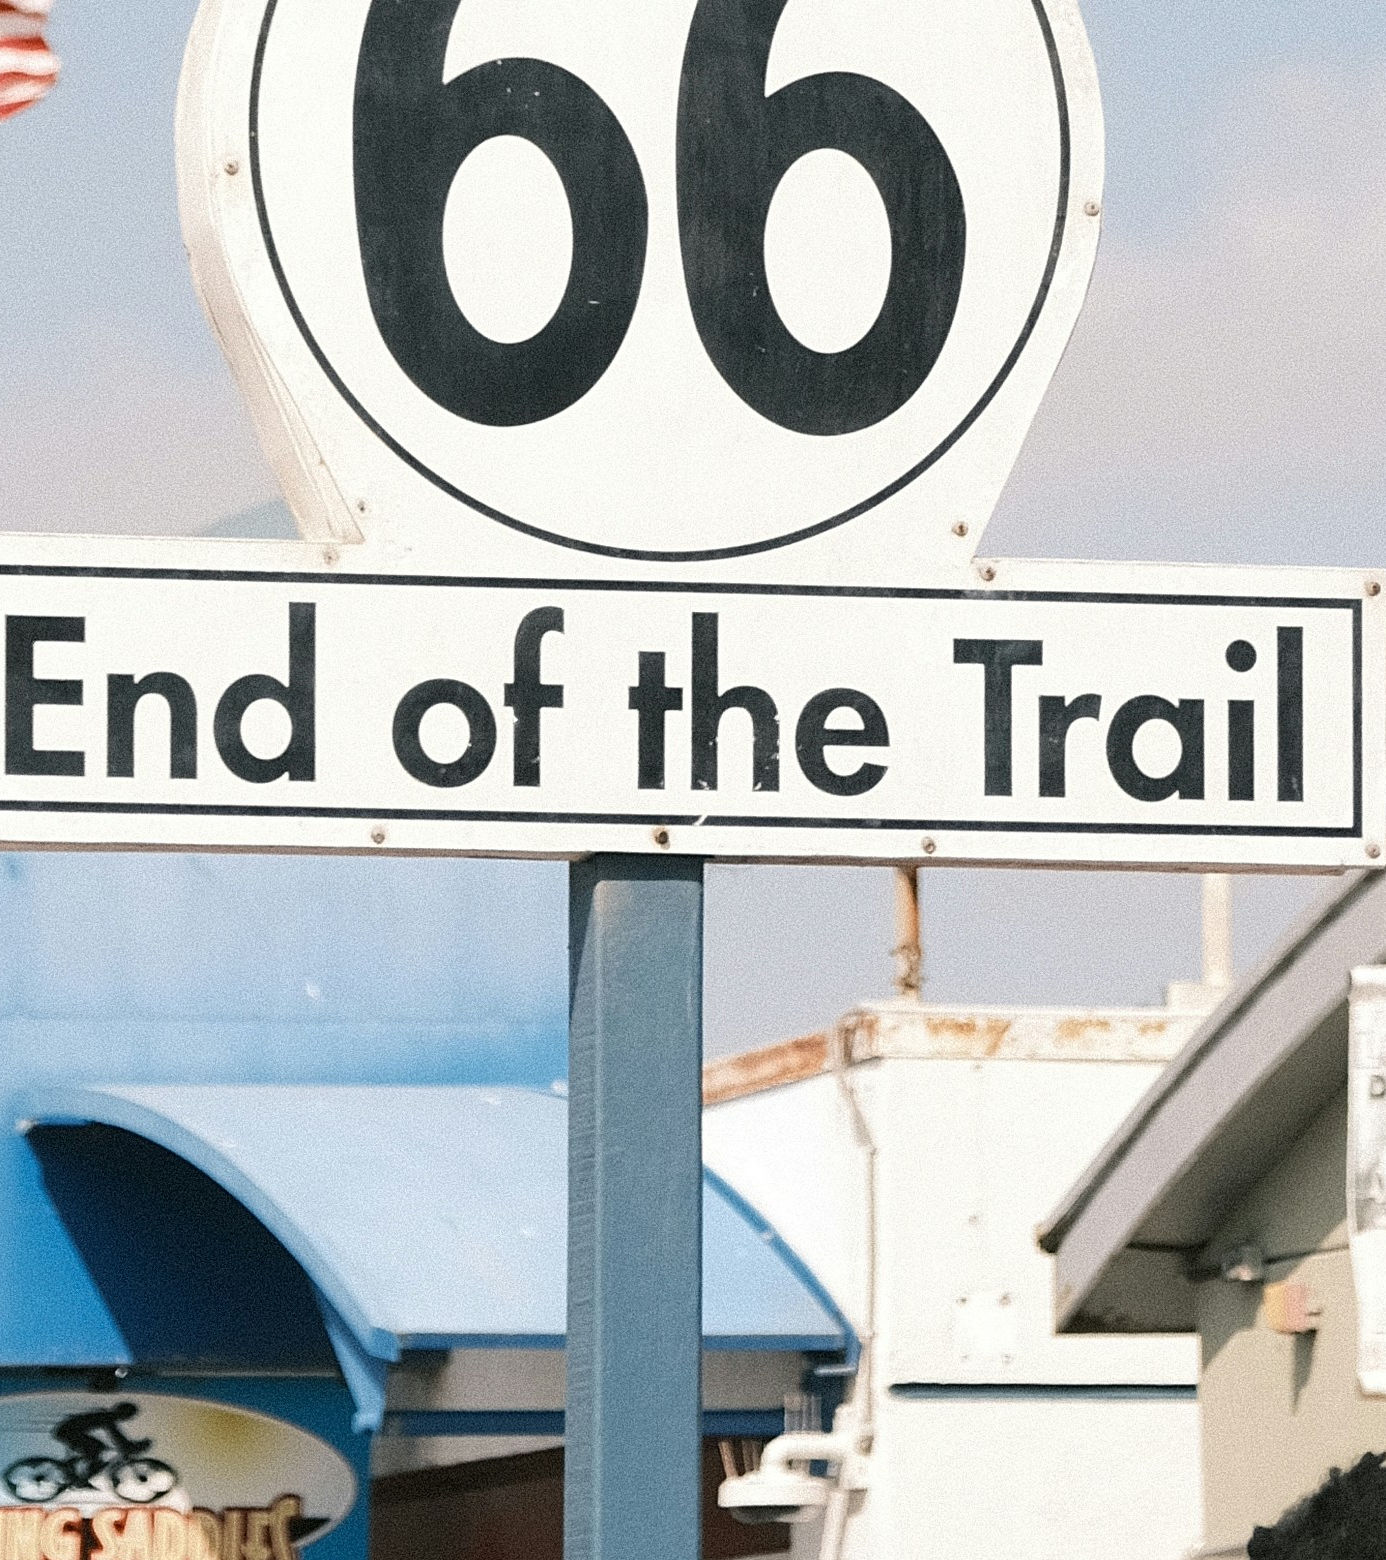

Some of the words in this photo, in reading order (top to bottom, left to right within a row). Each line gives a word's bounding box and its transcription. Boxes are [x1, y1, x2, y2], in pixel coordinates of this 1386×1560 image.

[1, 602, 316, 786] End
[391, 605, 563, 788] of
[627, 612, 891, 797] the
[952, 626, 1305, 804] Trail
